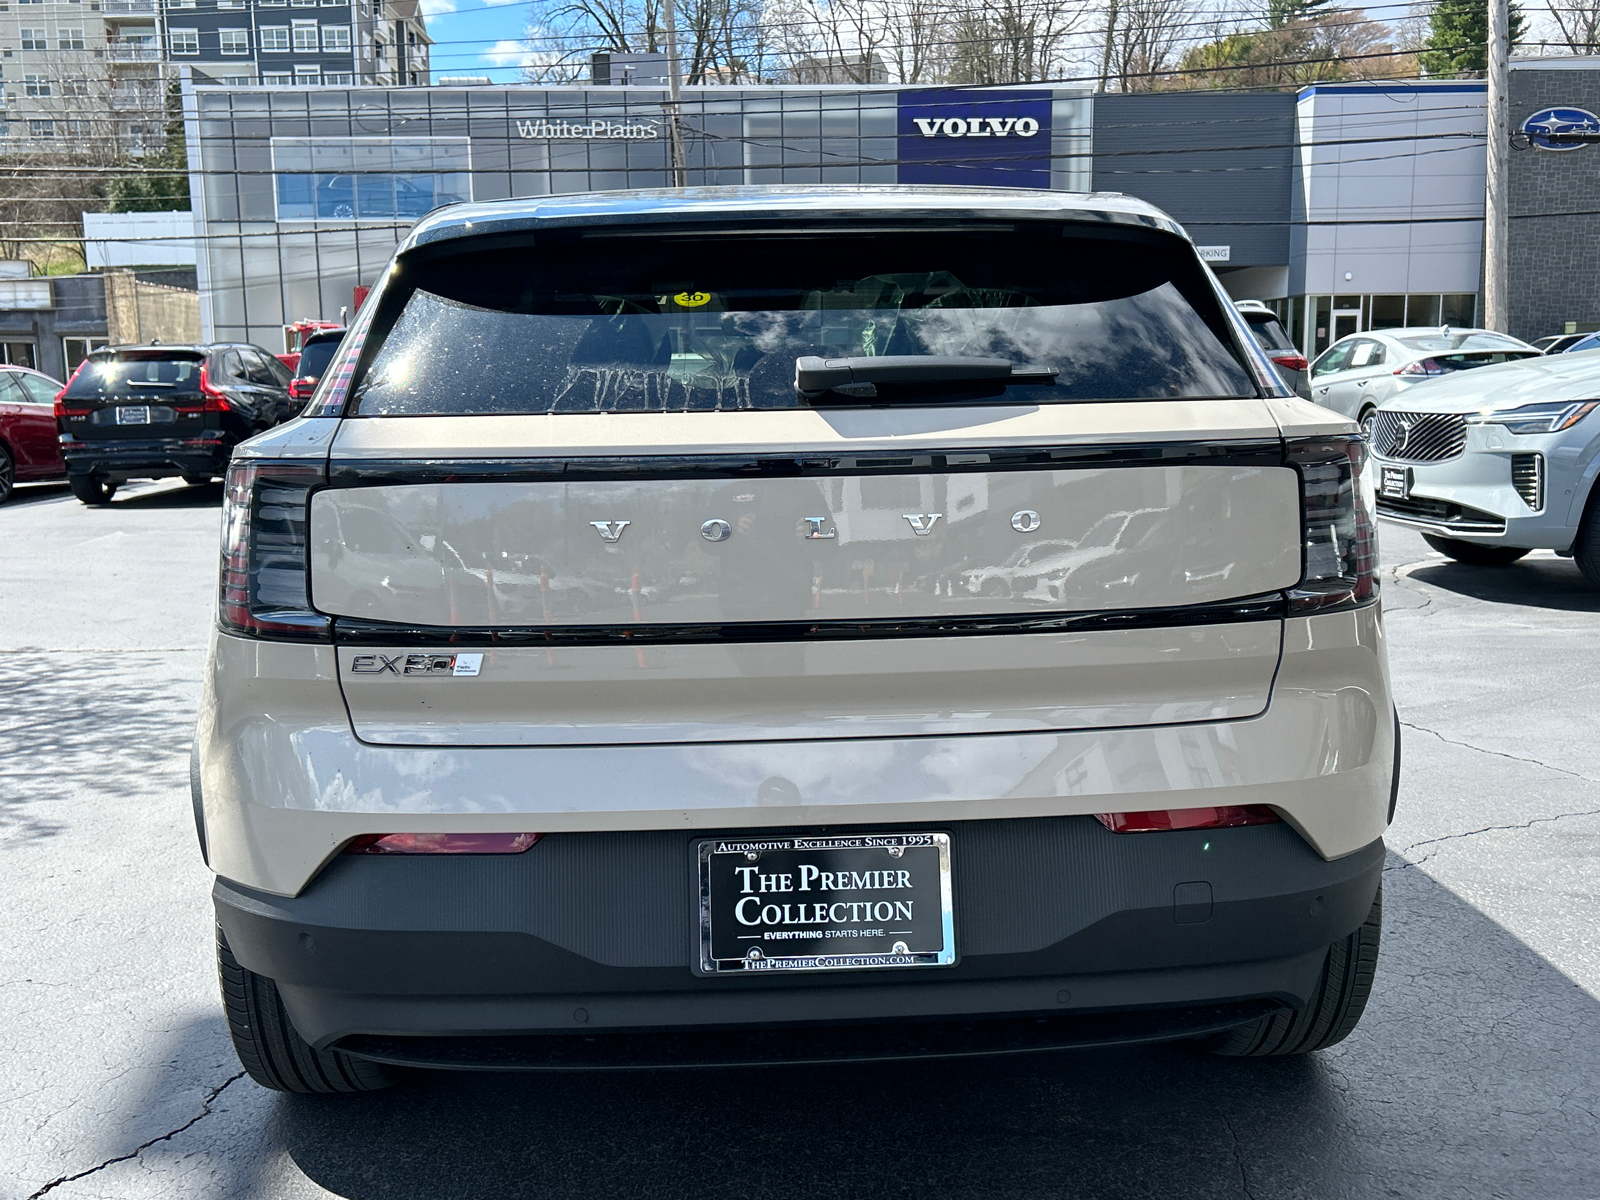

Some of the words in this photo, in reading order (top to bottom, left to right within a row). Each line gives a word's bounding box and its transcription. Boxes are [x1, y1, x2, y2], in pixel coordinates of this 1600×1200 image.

[516, 119, 583, 139] White
[591, 119, 657, 139] Plains
[913, 117, 1039, 137] VOLVO
[1199, 249, 1227, 258] RKING
[681, 294, 704, 302] 30
[589, 509, 1042, 543] VOLVO
[352, 653, 454, 676] EX30
[717, 840, 791, 852] AUTOMOTIVE
[793, 839, 862, 850] EXCELLENCE
[864, 837, 898, 847] SINCE
[901, 835, 932, 846] 1995
[734, 866, 794, 894] THE
[798, 864, 914, 892] PREMIER
[734, 896, 914, 926] COLLECTION
[763, 930, 823, 941] EVERYTHING
[824, 929, 858, 939] STARTS
[859, 928, 886, 938] HERE.
